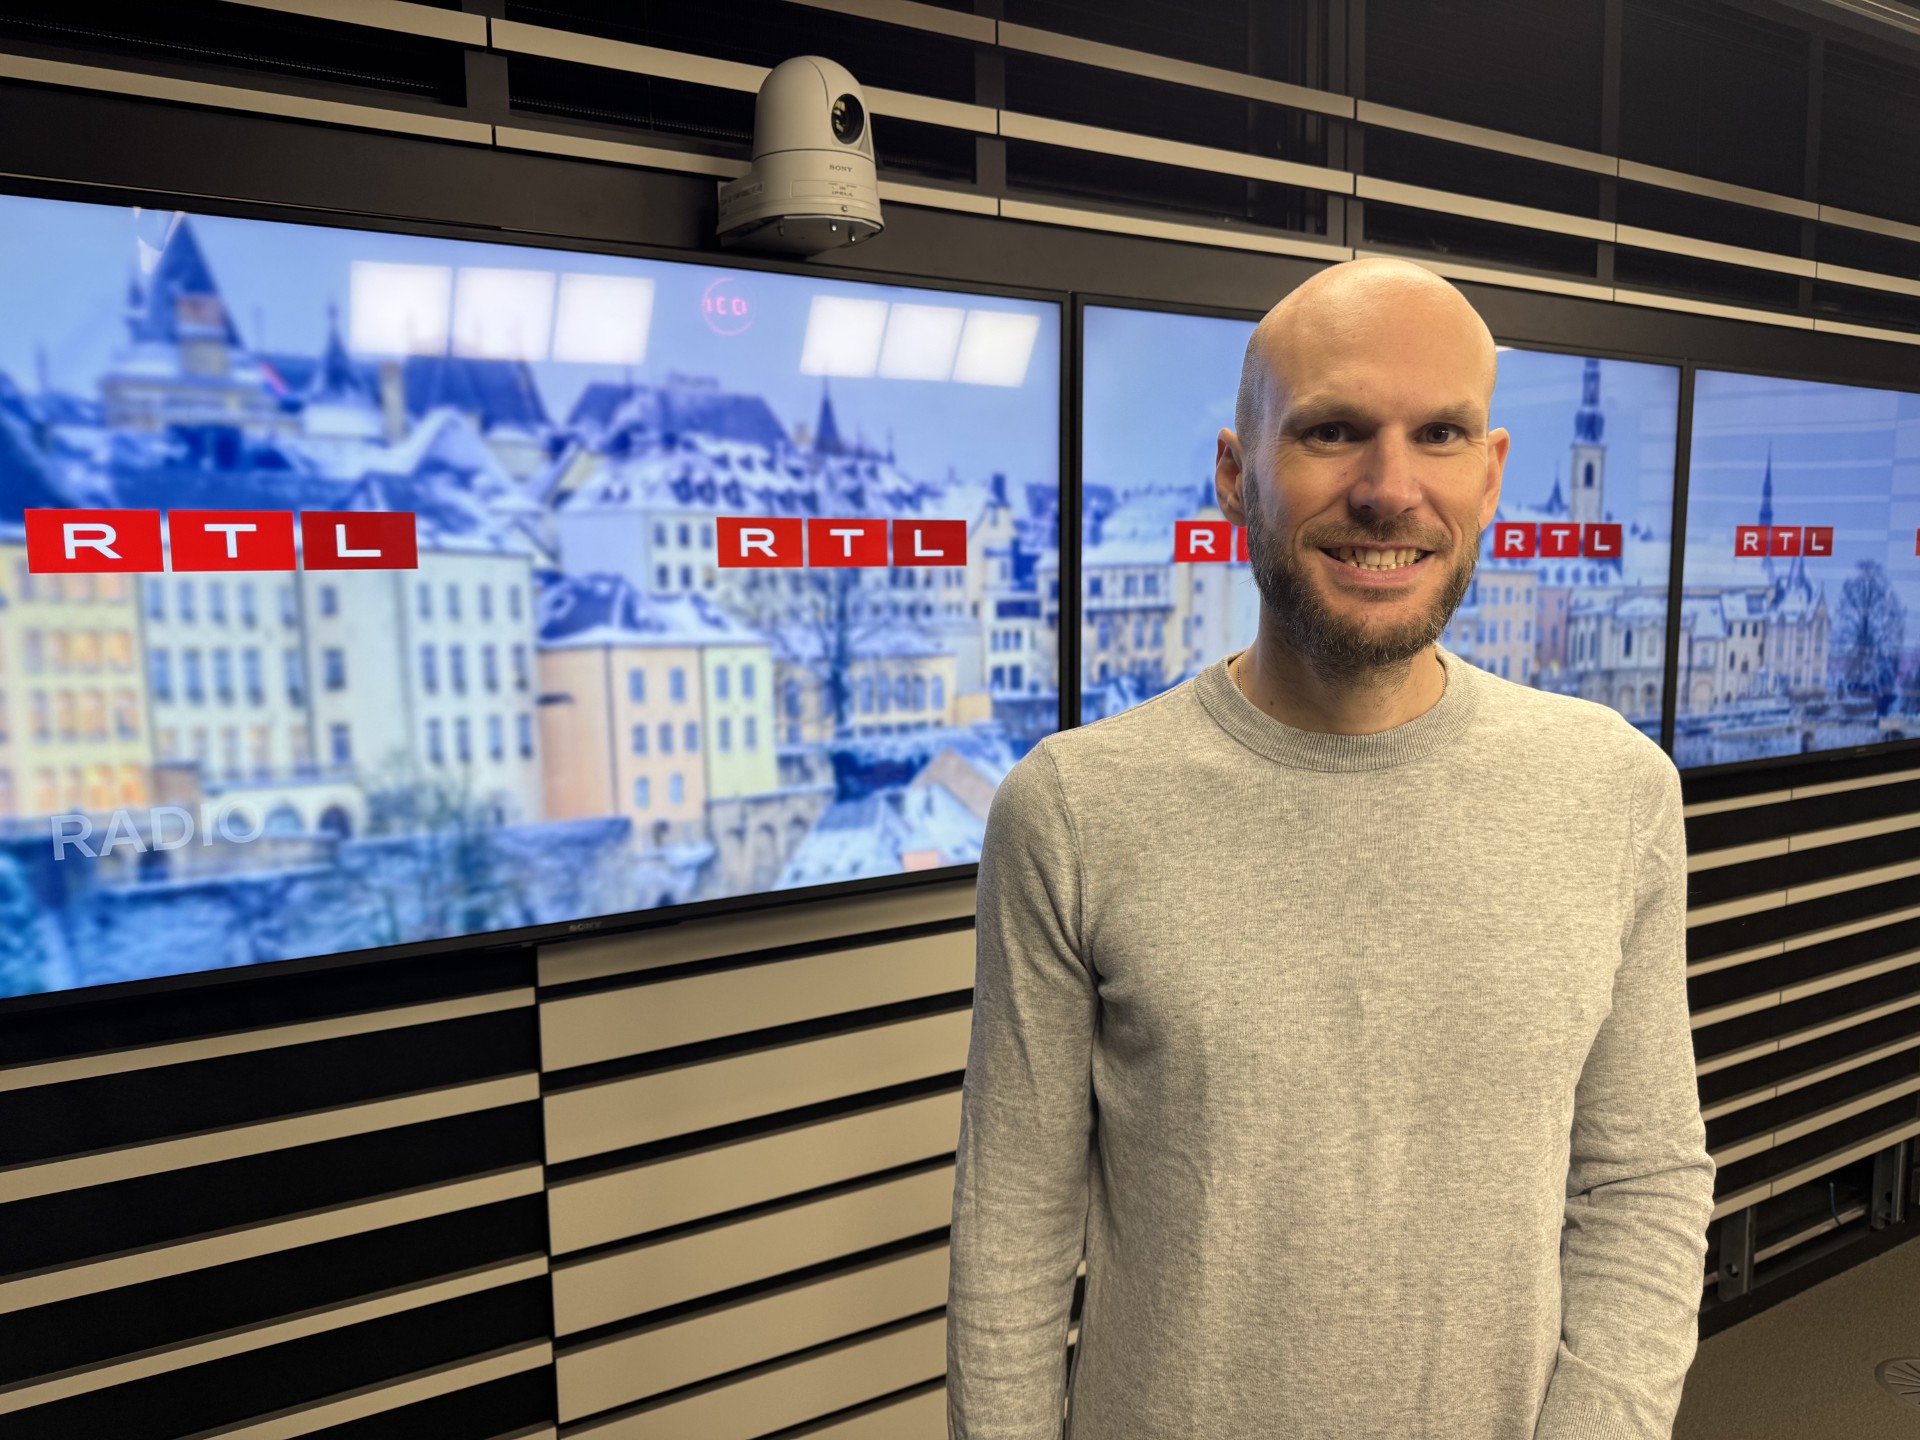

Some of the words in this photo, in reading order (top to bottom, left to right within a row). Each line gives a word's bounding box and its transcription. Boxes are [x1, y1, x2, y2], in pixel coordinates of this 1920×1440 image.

[829, 164, 853, 172] SONY
[63, 523, 381, 559] RTL
[740, 528, 944, 557] RTL
[1505, 529, 1611, 551] RTL
[1744, 532, 1824, 551] RTL
[51, 799, 265, 861] RADIO
